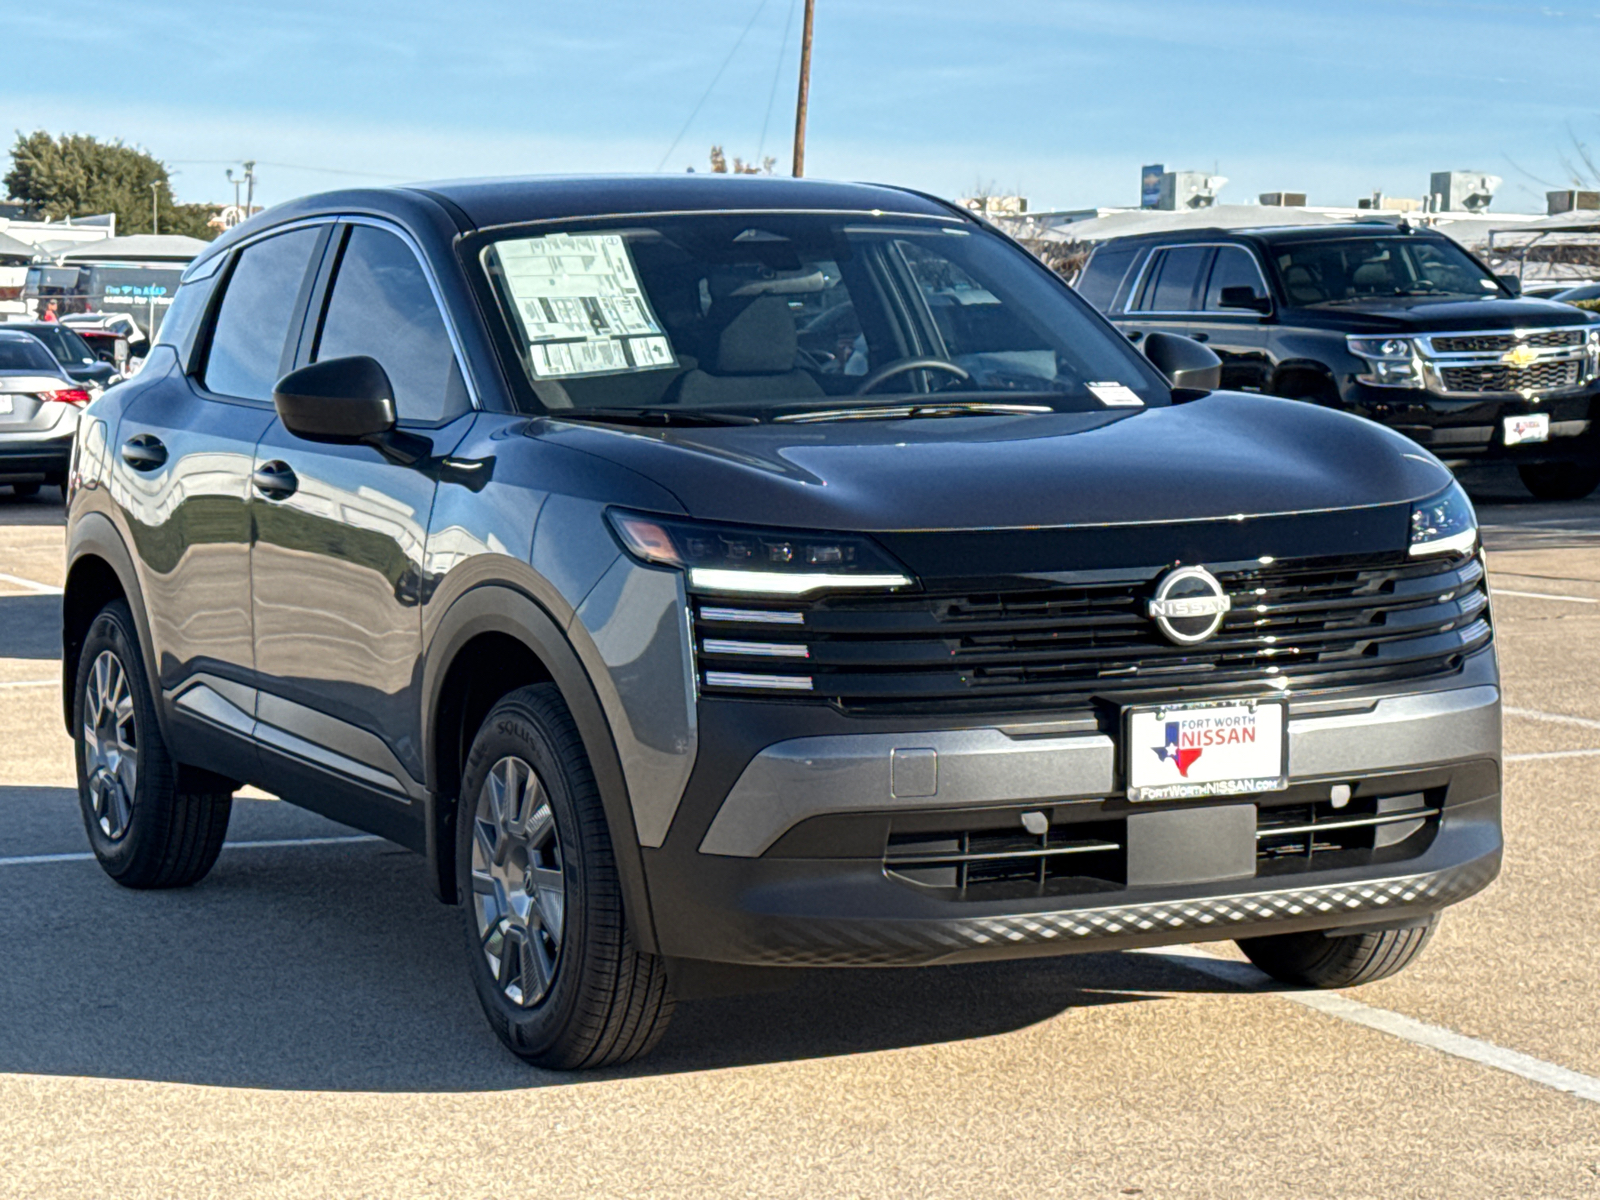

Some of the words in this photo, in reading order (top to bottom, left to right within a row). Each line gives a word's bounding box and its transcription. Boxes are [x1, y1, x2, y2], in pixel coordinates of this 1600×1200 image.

[1151, 599, 1229, 616] NISSAN
[1181, 718, 1211, 730] FORT
[1214, 715, 1256, 728] WORTH
[1181, 726, 1256, 748] NISSAN
